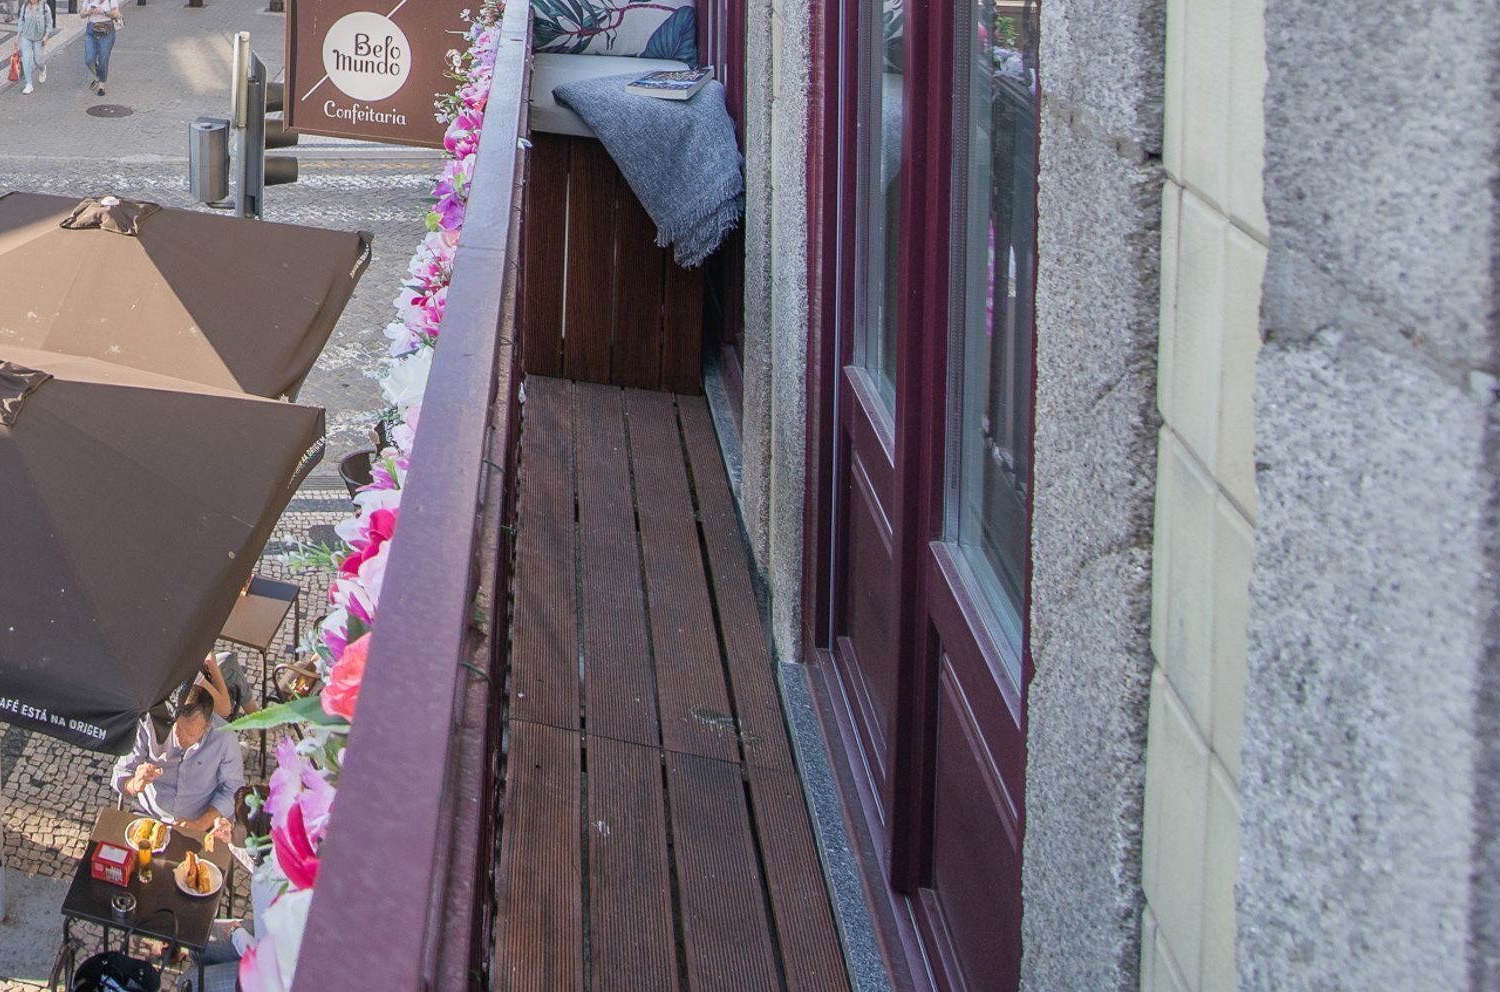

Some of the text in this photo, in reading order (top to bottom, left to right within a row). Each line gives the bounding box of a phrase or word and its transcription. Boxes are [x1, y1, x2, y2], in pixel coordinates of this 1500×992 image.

[355, 33, 401, 59] Belo
[324, 100, 406, 125] Confeitaria
[21, 704, 47, 721] ESTÁ
[51, 714, 66, 726] NA
[69, 719, 107, 740] ORIGEM
